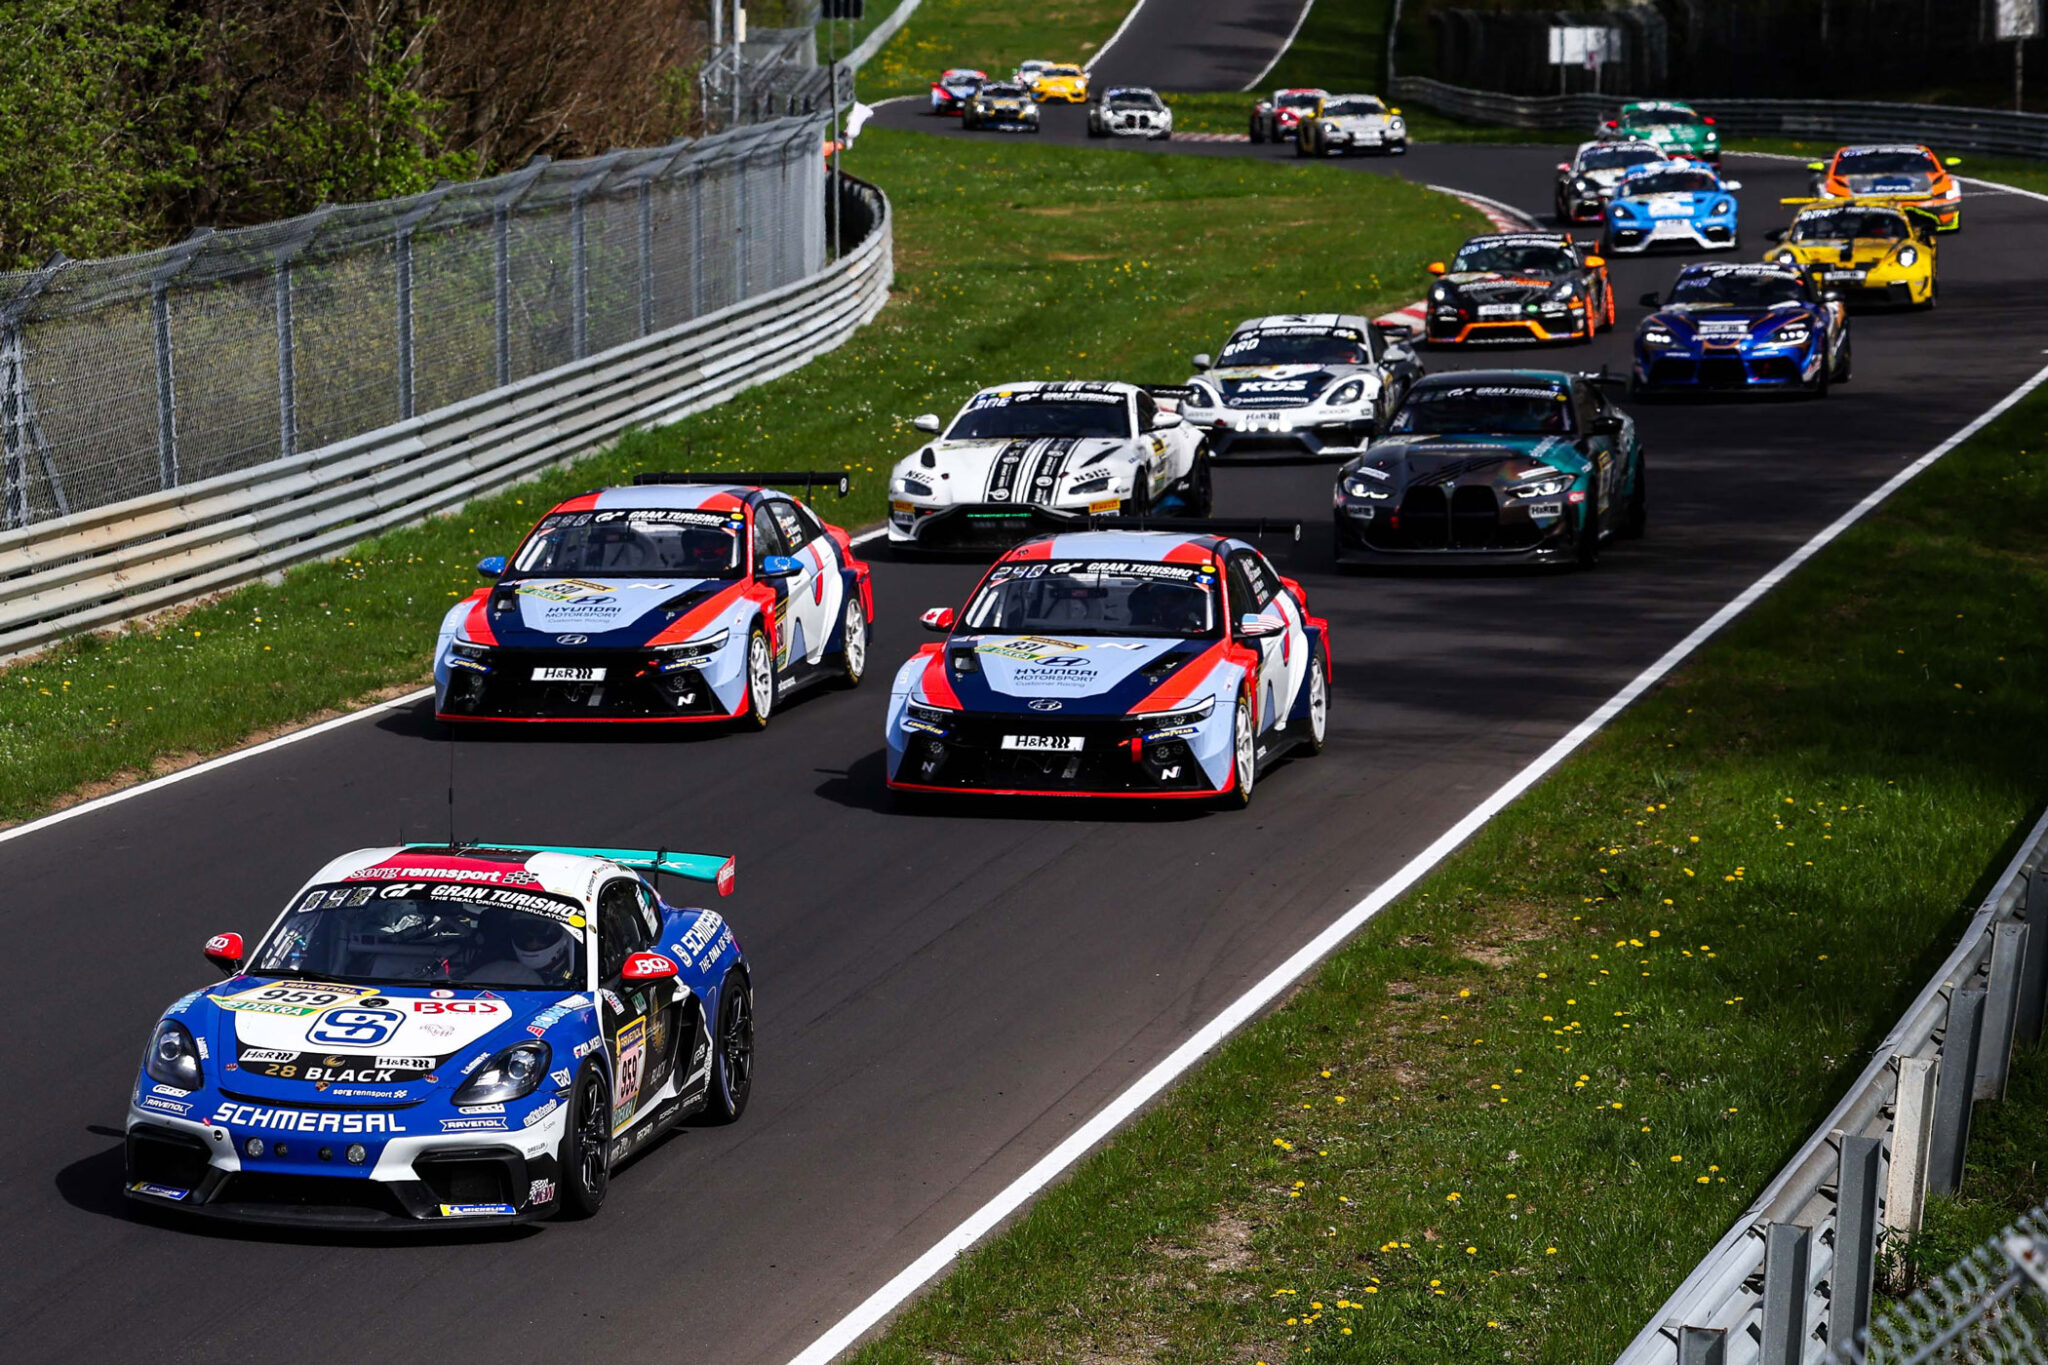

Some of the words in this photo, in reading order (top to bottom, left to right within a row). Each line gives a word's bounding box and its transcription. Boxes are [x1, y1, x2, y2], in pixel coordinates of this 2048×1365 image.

[1476, 387, 1506, 395] GRAN
[628, 511, 666, 520] GRAN
[667, 512, 723, 523] TURISMO
[1087, 562, 1128, 571] GRAN
[1130, 563, 1193, 576] TURISMO
[1004, 641, 1047, 652] 831
[1016, 668, 1098, 676] HYUNDAI
[1148, 728, 1194, 740] GOODYEAR
[351, 867, 401, 880] sorg
[401, 867, 502, 882] rennsport
[431, 884, 490, 900] GRAN
[452, 895, 474, 904] REAL
[476, 899, 514, 909] DRIVING
[515, 905, 570, 923] SIMULATOR
[699, 955, 712, 975] THE
[284, 982, 358, 994] RAVENOL
[257, 989, 338, 1006] 959
[243, 1002, 301, 1015] DEKRA
[414, 1001, 498, 1014] BGS
[265, 1063, 297, 1078] 28
[304, 1067, 396, 1082] BLACK
[353, 1089, 392, 1098] rennsport
[146, 1099, 184, 1112] RAVENOL
[212, 1102, 406, 1132] SCHMERSAL
[448, 1120, 502, 1128] RAVENOL
